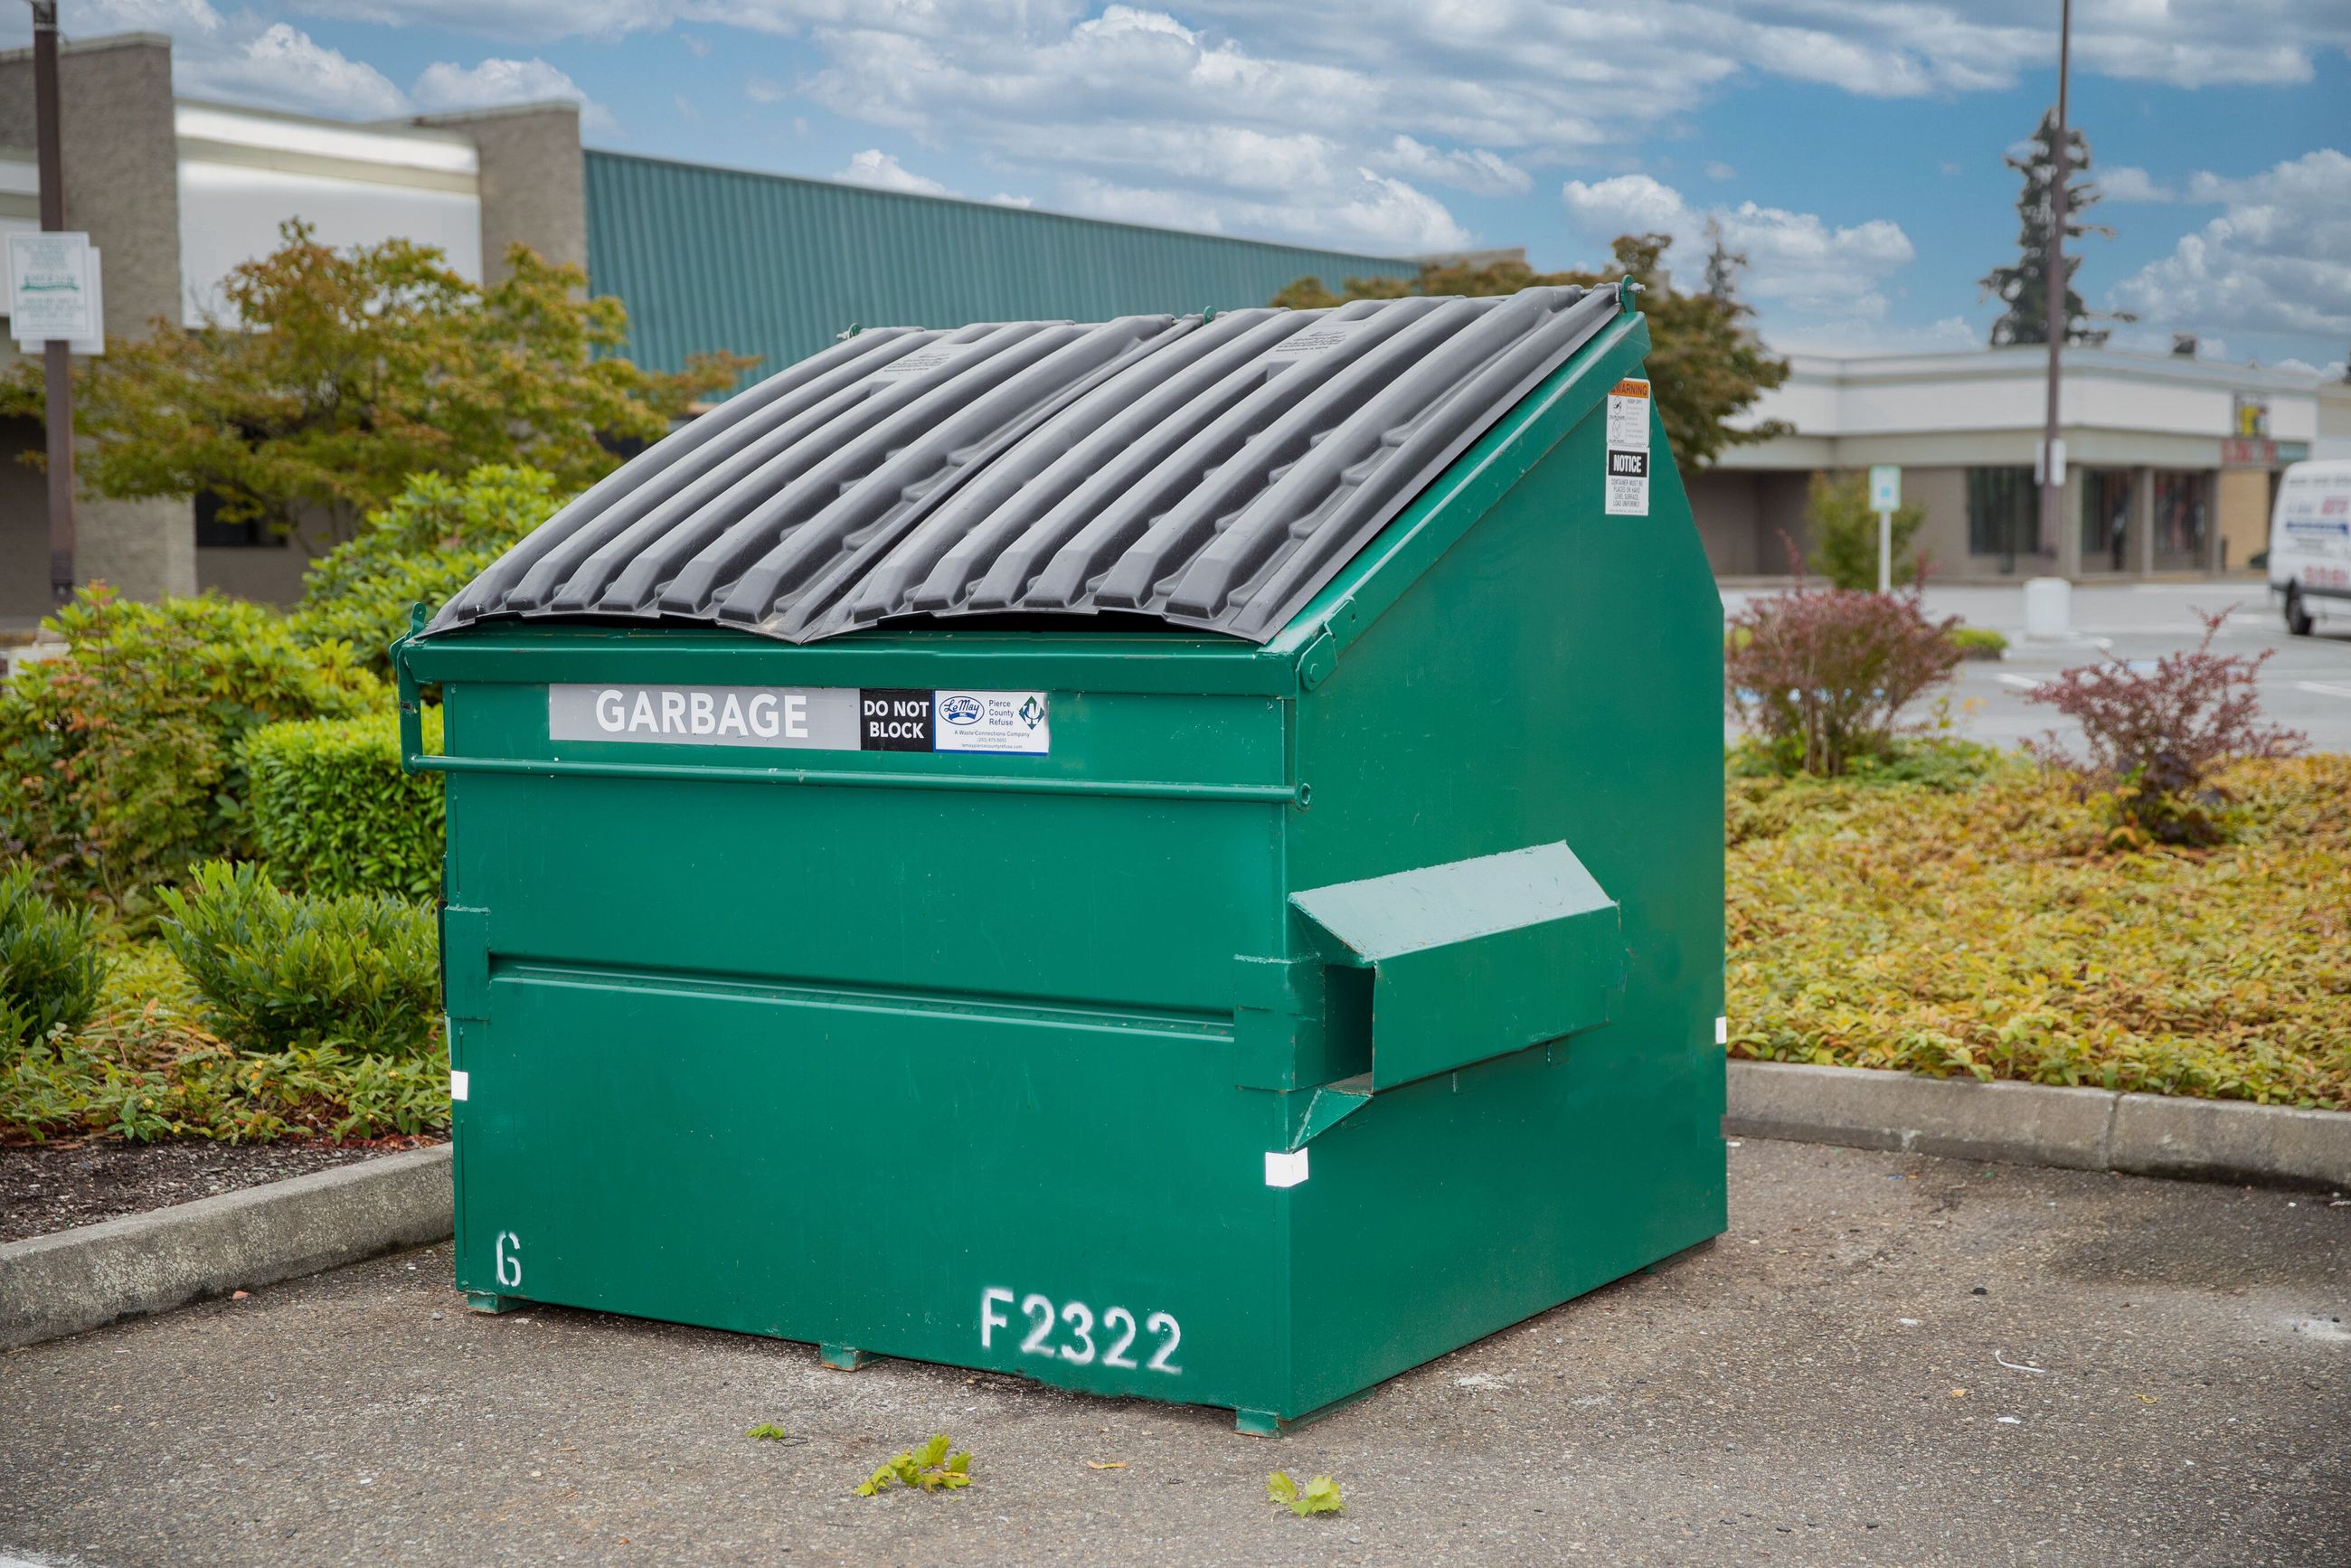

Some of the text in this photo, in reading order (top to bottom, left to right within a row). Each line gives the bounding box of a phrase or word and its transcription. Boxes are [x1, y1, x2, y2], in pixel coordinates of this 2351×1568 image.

[1615, 383, 1648, 396] WARNING
[1614, 454, 1641, 473] NOTICE
[596, 689, 808, 738] GARBAGE
[864, 700, 930, 717] DO NOT
[988, 709, 1015, 718] County
[870, 722, 924, 739] BLOCK
[989, 718, 1014, 726] Refuse
[981, 1286, 1183, 1375] F2322
